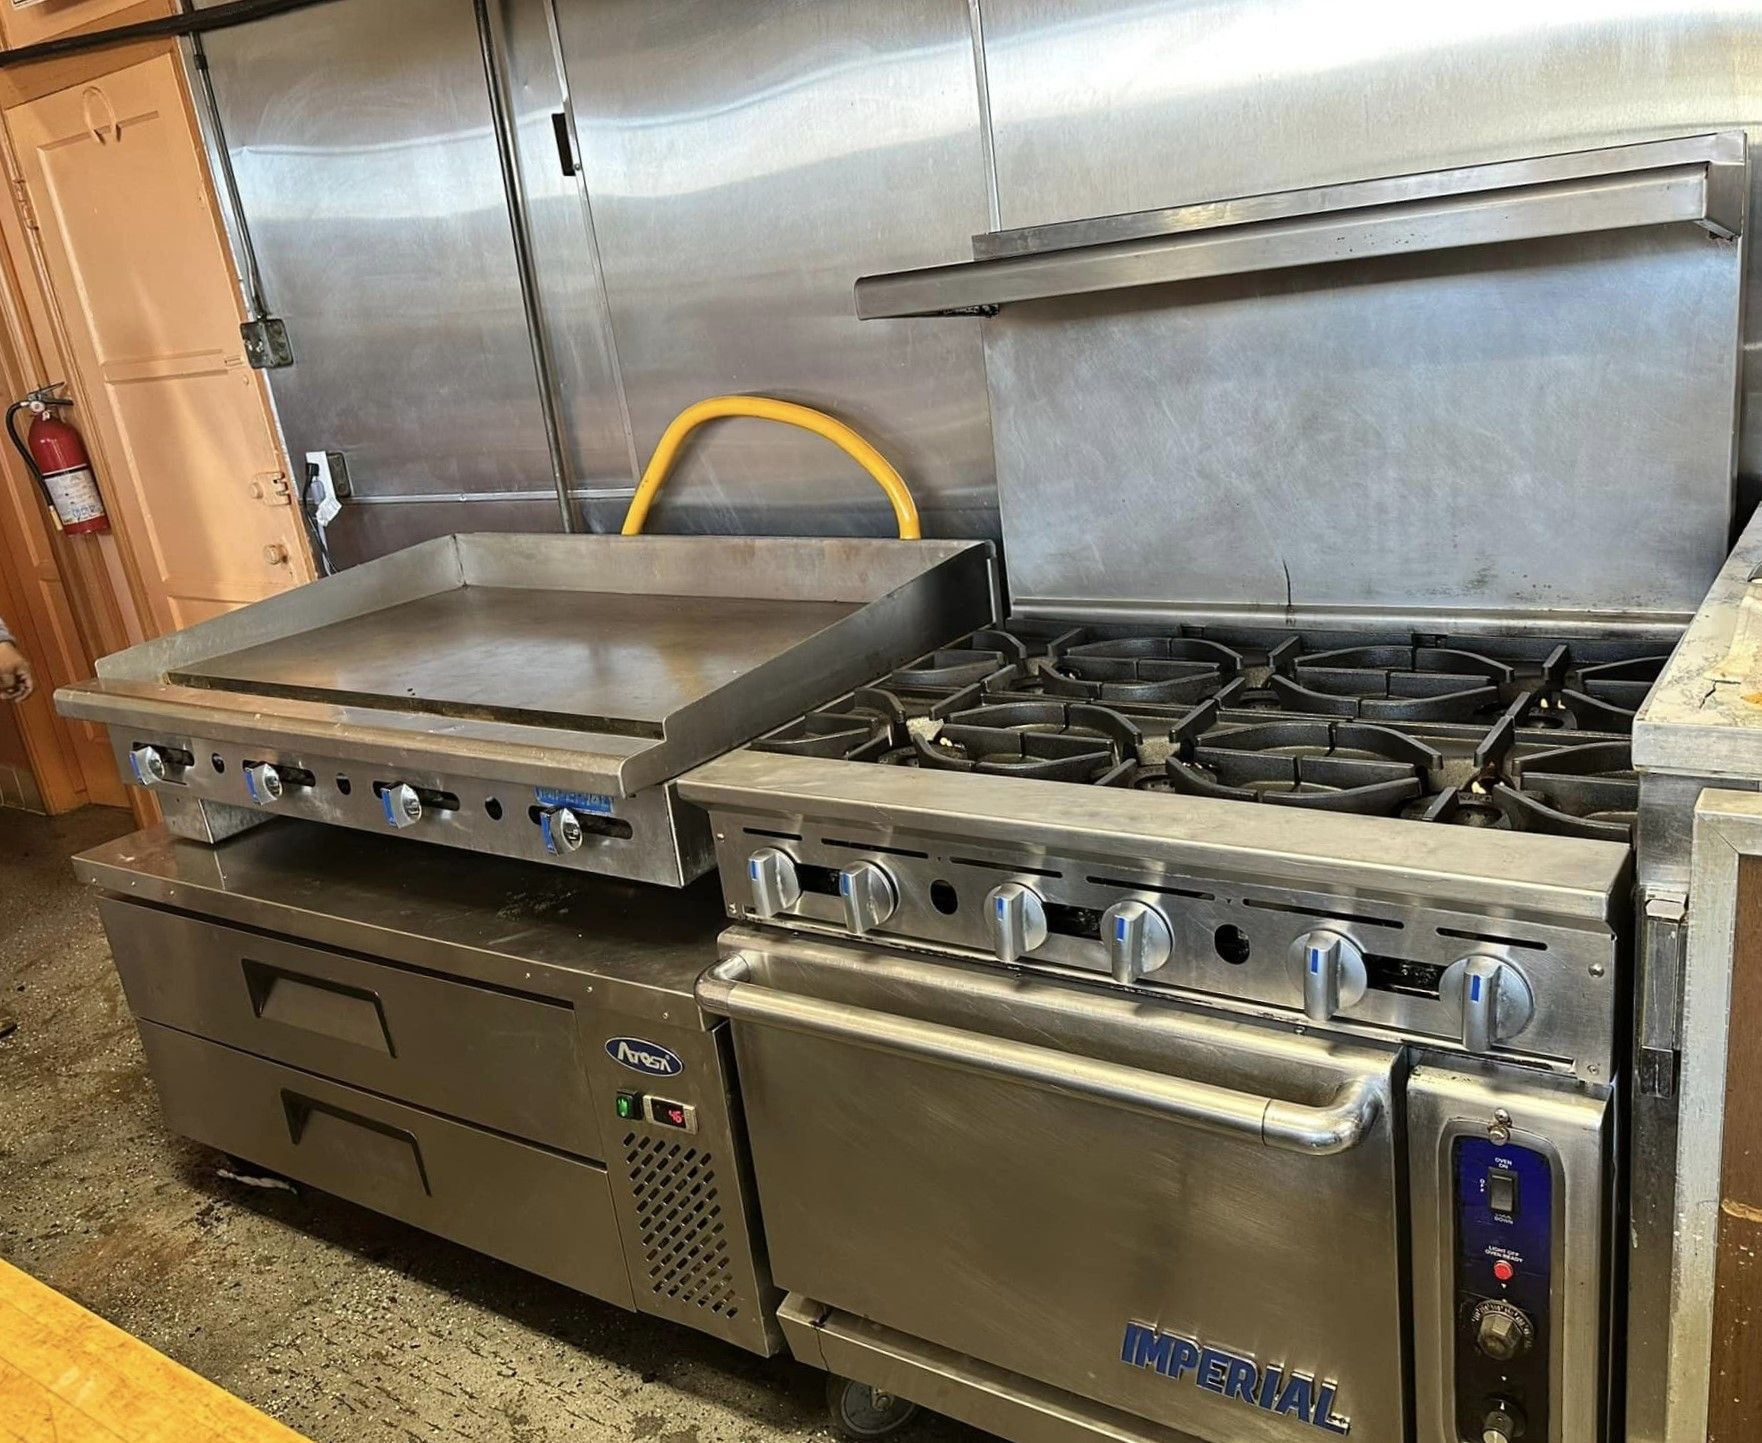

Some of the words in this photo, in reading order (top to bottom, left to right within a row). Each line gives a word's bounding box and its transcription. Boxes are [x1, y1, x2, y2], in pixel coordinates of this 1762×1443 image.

[1494, 1157, 1513, 1166] OVEN
[1484, 1248, 1502, 1257] OVEN
[1119, 1318, 1351, 1437] IMPERIAL
